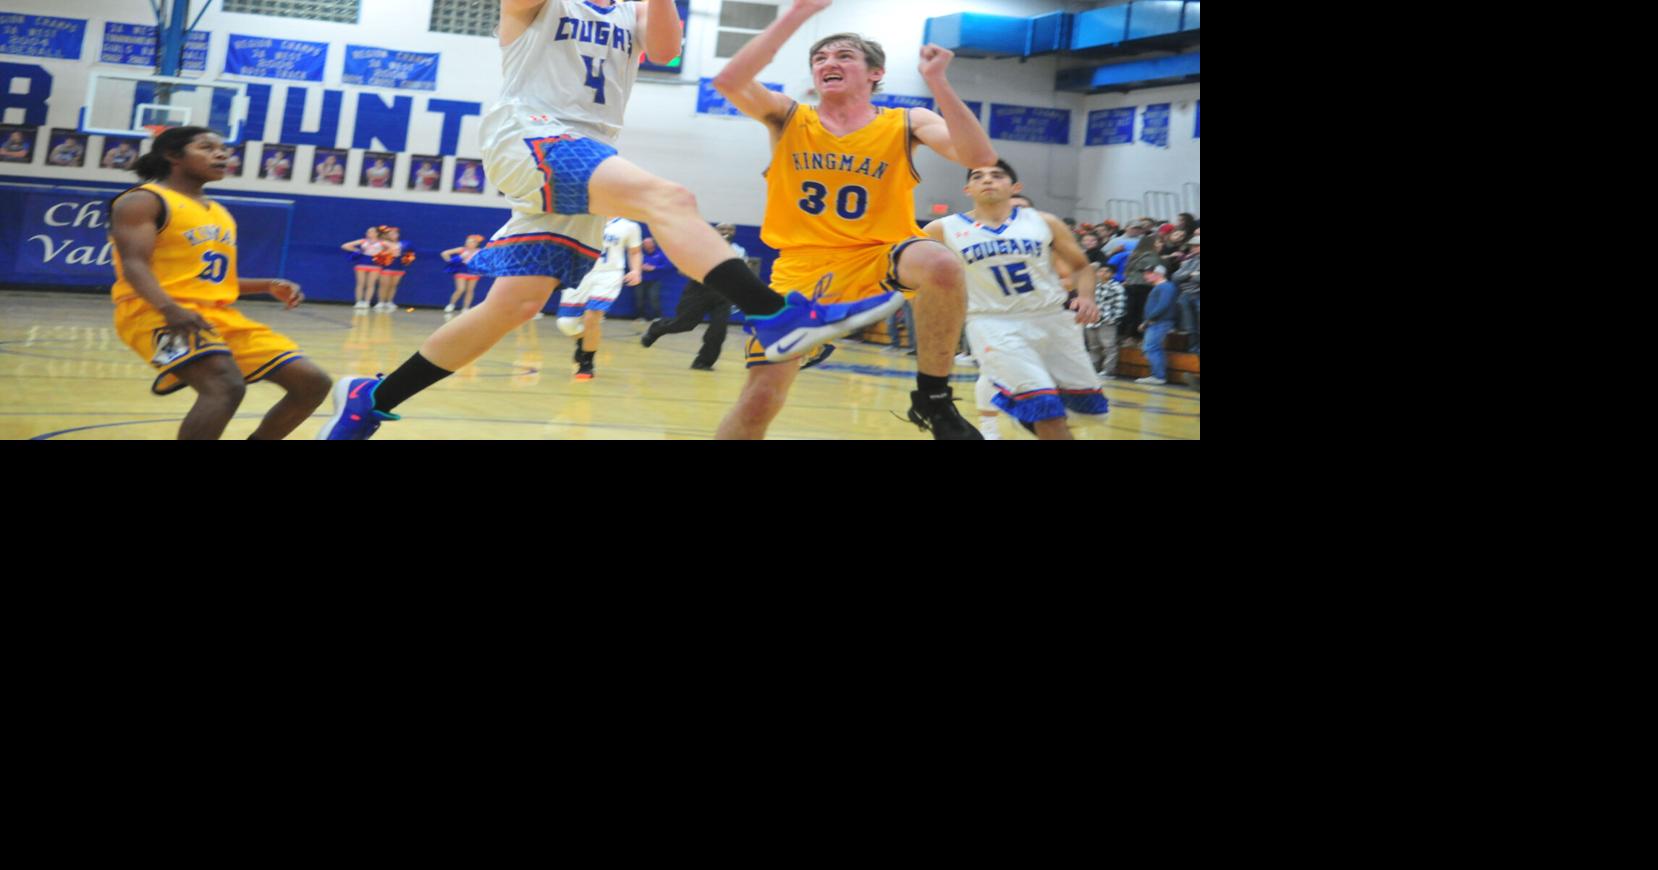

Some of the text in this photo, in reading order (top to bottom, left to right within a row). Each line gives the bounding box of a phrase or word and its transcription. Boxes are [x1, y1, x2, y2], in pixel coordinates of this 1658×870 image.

[580, 55, 605, 104] 4
[792, 152, 888, 179] KINGMAN
[798, 180, 868, 220] 30
[200, 249, 229, 284] 20
[961, 239, 1042, 264] COUGARS
[990, 262, 1034, 296] 15
